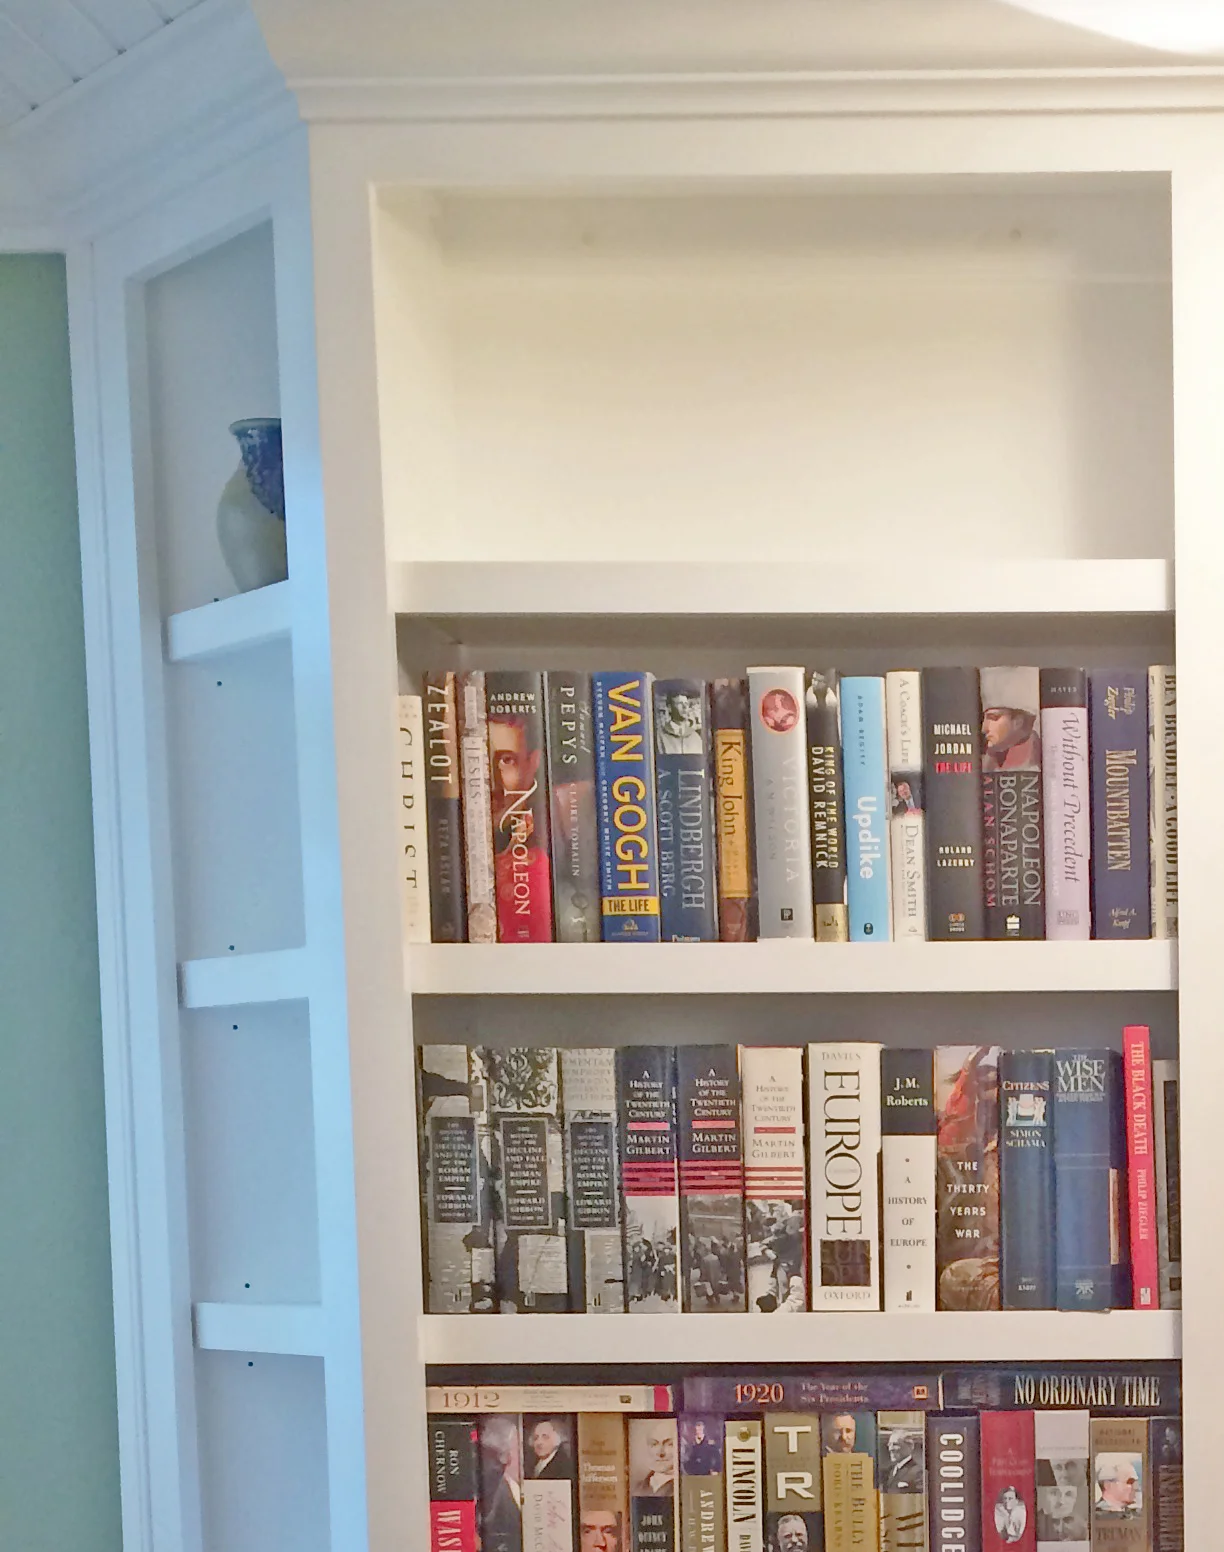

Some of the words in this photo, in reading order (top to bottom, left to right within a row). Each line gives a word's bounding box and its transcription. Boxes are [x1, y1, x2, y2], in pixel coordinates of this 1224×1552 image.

[490, 693, 535, 702] ANDREW
[490, 705, 536, 714] ROBERTS
[427, 685, 452, 784] ZEALOT
[560, 686, 577, 765] PEPYS
[608, 680, 644, 762] VAN
[934, 724, 971, 736] MICHAEL
[934, 743, 972, 755] JORDAN
[1062, 712, 1079, 789] Without
[718, 740, 744, 789] King
[811, 747, 824, 794] DAVID
[719, 794, 738, 837] John
[1106, 749, 1137, 872] MOUNTBATTEN
[500, 778, 538, 915] NAPOLEON
[611, 775, 650, 891] GOGH
[676, 768, 706, 911] LINDBERGH
[813, 800, 828, 869] REMNICK
[856, 796, 884, 880] Updike
[1000, 775, 1020, 907] BONAPARTE
[1021, 775, 1042, 907] NAPOLEON
[1063, 796, 1080, 883] Precedent
[608, 900, 624, 912] THE
[627, 899, 650, 912] LIFE
[1131, 1041, 1143, 1066] THE
[1057, 1060, 1104, 1077] WISE
[894, 1078, 902, 1088] J.
[906, 1078, 919, 1088] M.
[1002, 1080, 1049, 1090] CITIZENS
[1058, 1077, 1104, 1093] MEN
[1131, 1069, 1145, 1110] BLACK
[887, 1096, 928, 1106] Roberts
[627, 1135, 669, 1144] MARTIN
[692, 1133, 736, 1142] MARTIN
[1133, 1113, 1147, 1155] DEATH
[627, 1146, 670, 1155] GILBERT
[692, 1144, 737, 1153] GILBERT
[823, 1069, 863, 1236] EUROPE
[958, 1162, 978, 1170] THE
[947, 1184, 989, 1193] THIRTY
[950, 1207, 986, 1216] YEARS
[890, 1238, 927, 1247] EUROPE
[956, 1229, 980, 1238] WAR
[442, 1393, 501, 1408] 1912
[735, 1384, 784, 1403] 1920
[1014, 1377, 1035, 1404] NO
[1039, 1377, 1116, 1405] ORDINARY
[1122, 1377, 1160, 1405] TIME
[774, 1426, 811, 1453] T
[732, 1448, 756, 1523] LINCOLN
[776, 1472, 814, 1499] R
